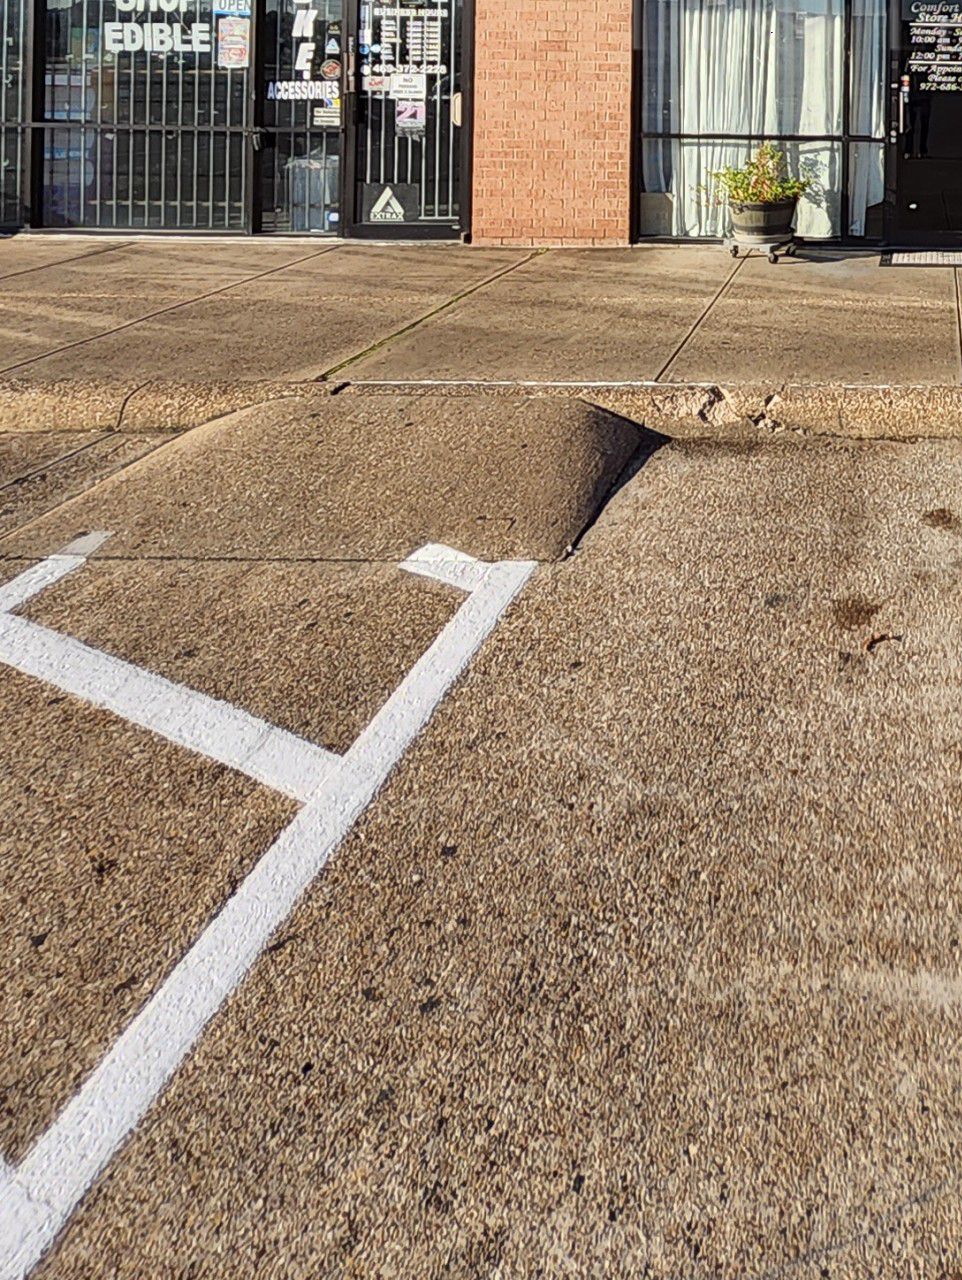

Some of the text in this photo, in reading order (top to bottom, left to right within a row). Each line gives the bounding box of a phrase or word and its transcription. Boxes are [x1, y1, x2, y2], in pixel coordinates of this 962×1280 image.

[911, 1, 959, 14] Comfort
[916, 12, 948, 23] Store
[104, 22, 211, 52] EDIBLE
[910, 27, 947, 38] Monday
[911, 36, 936, 44] 10:00
[911, 52, 936, 60] 12:00
[267, 81, 340, 100] ACCESSORIES
